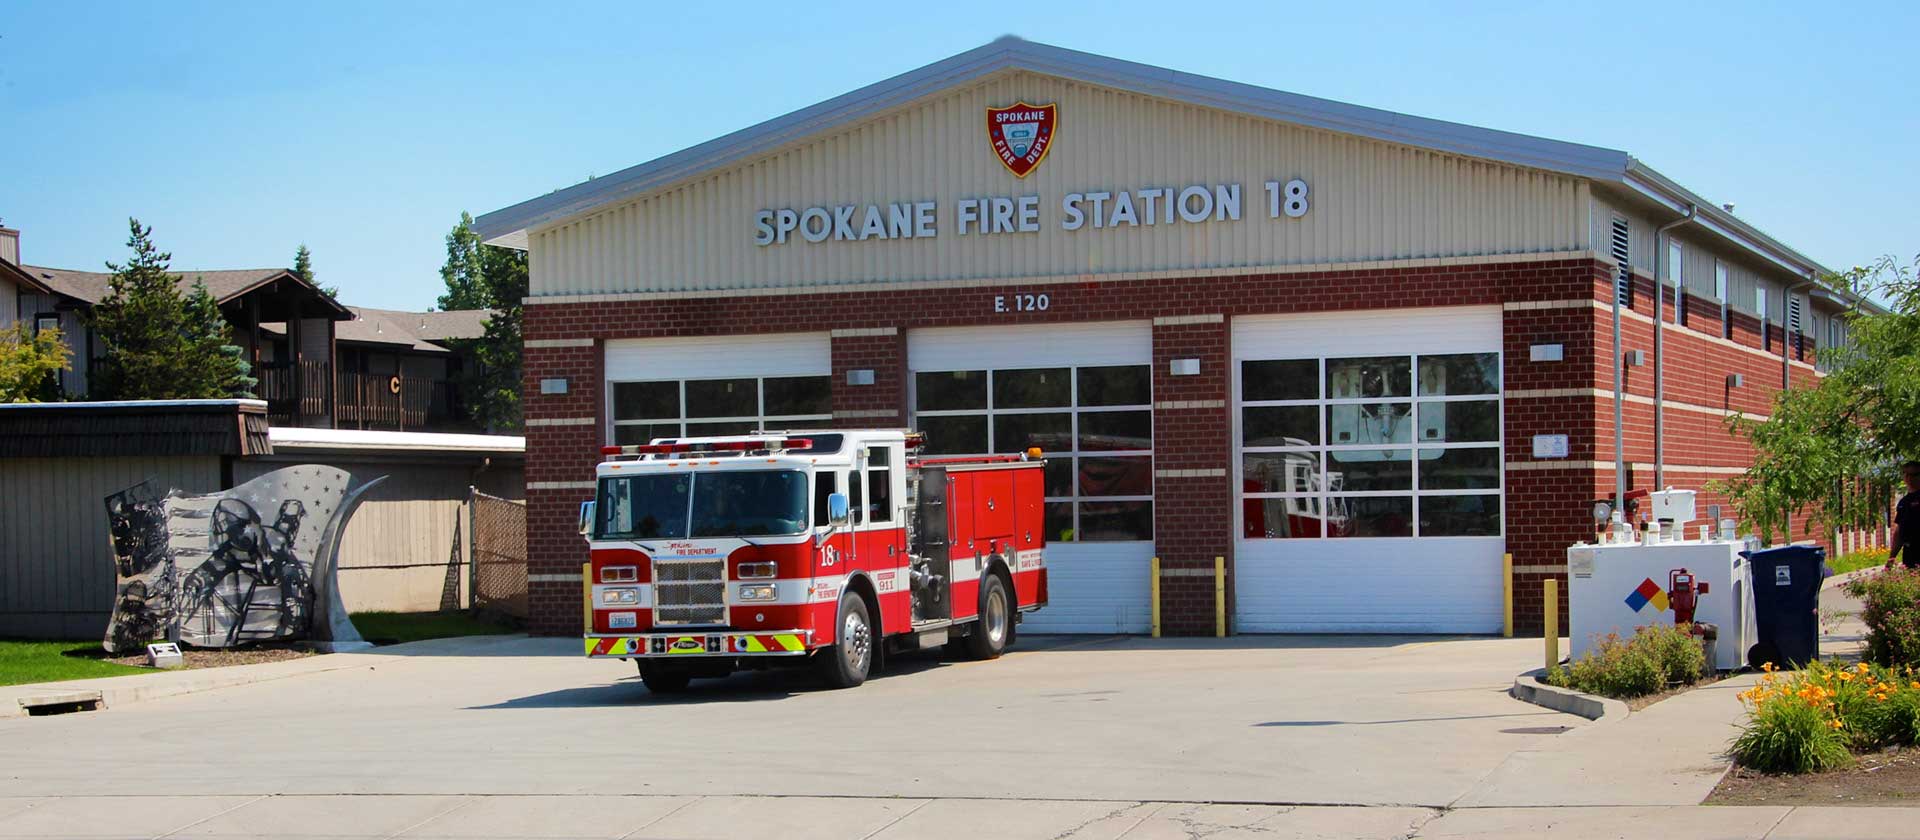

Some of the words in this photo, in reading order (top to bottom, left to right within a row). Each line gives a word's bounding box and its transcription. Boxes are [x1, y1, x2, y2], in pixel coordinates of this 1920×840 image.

[996, 111, 1045, 122] SPOKANE
[995, 140, 1016, 166] FIRE
[1026, 136, 1048, 164] DEPT.
[754, 202, 937, 247] SPOKANE
[957, 196, 1041, 235] FIRE
[1062, 184, 1241, 231] STATION
[1265, 180, 1309, 218] 18
[995, 296, 1009, 312] E.
[1015, 294, 1049, 311] 120
[390, 376, 400, 394] C
[821, 544, 834, 567] 18
[879, 580, 893, 590] 911
